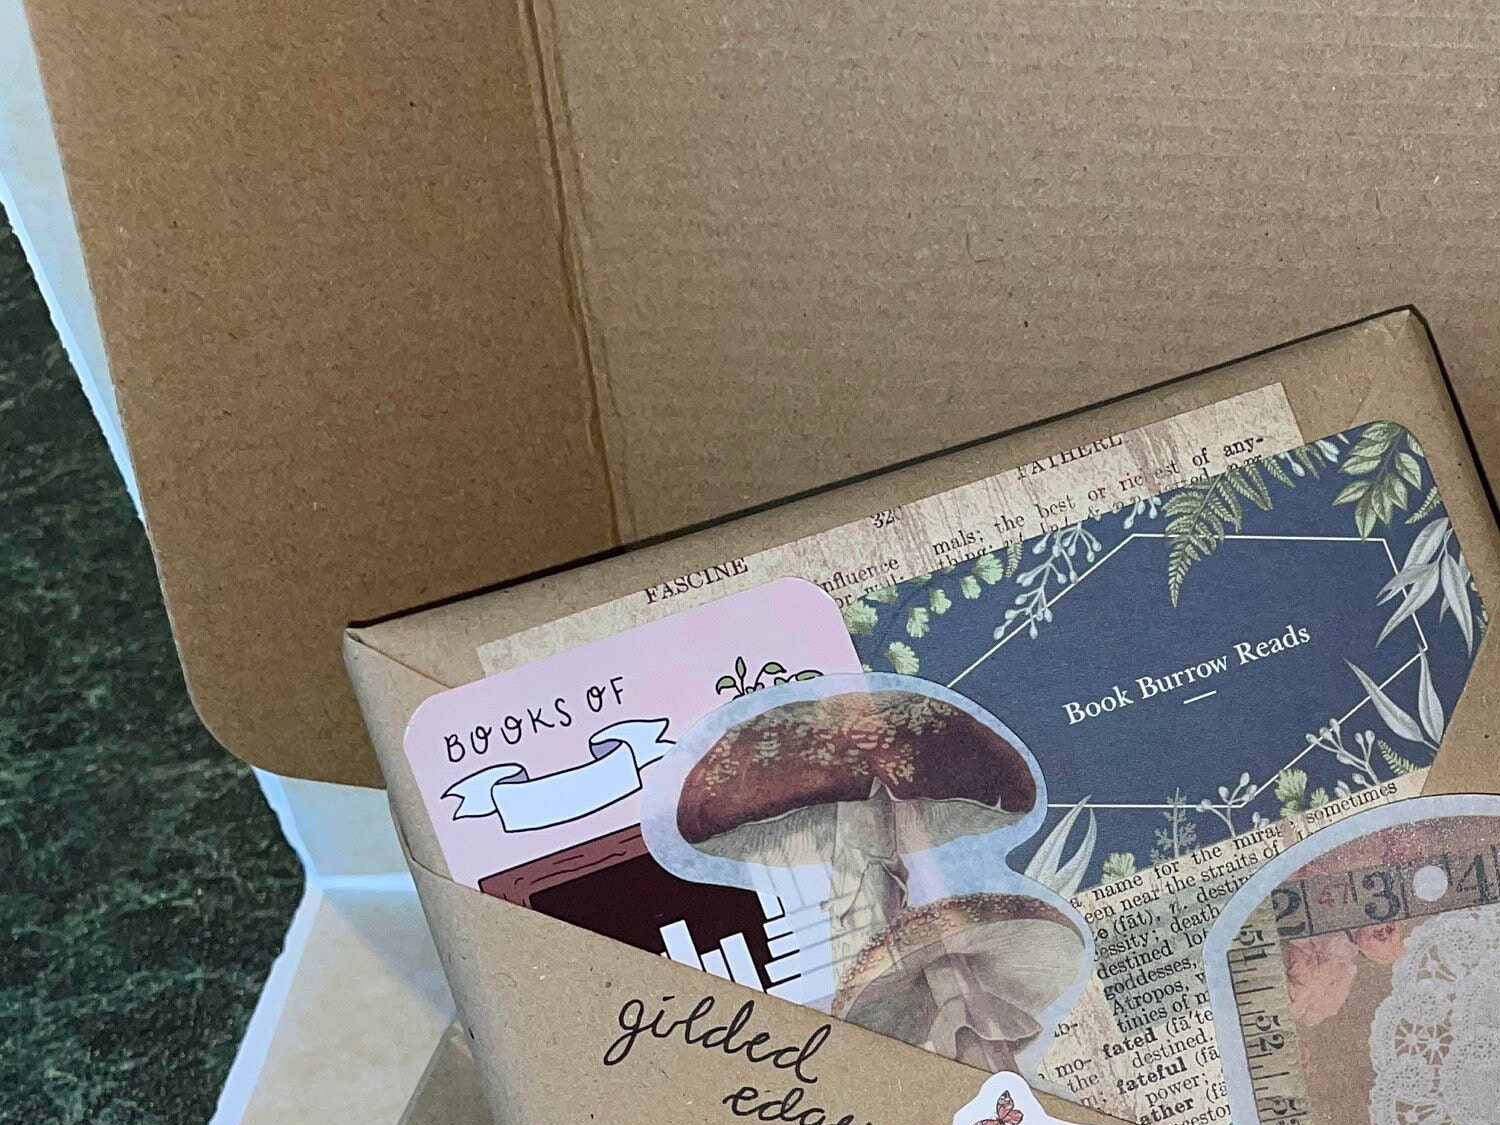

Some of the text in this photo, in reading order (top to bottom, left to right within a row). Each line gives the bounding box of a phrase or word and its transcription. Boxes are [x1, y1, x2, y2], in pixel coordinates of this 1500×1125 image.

[932, 531, 984, 556] mals;
[994, 515, 1025, 535] the
[1035, 494, 1075, 519] best
[1087, 487, 1106, 501] or
[1119, 459, 1179, 492] ricest
[1192, 447, 1208, 467] of
[1223, 437, 1264, 458] any-
[644, 557, 749, 605] FASCINE
[1062, 623, 1312, 726] Book Burrow Reads
[444, 676, 625, 764] BOOKS OF
[1092, 873, 1143, 902] name
[1154, 861, 1180, 880] for
[1191, 845, 1222, 866] the
[1306, 781, 1398, 824] sometimes
[1120, 889, 1160, 912] near
[1165, 875, 1196, 895] the
[1200, 851, 1259, 883] straits
[1263, 840, 1280, 861] of
[1271, 888, 1306, 937] 2
[1362, 871, 1400, 921] 3
[1456, 853, 1498, 905] 4
[1170, 904, 1221, 934] death
[1096, 940, 1174, 980] destined
[1104, 958, 1197, 1000] goddesses,
[1112, 979, 1190, 1016] Atropos,
[1116, 1006, 1168, 1034] tinies
[1172, 996, 1188, 1012] of
[604, 996, 832, 1084] gilded
[1102, 1028, 1159, 1060] fated
[1132, 1027, 1214, 1068] destined.
[1255, 1014, 1285, 1050] 52
[1054, 1058, 1092, 1078] mo-
[1067, 1074, 1099, 1094] the
[1116, 1057, 1188, 1095] fateful
[1145, 1073, 1209, 1108] power;
